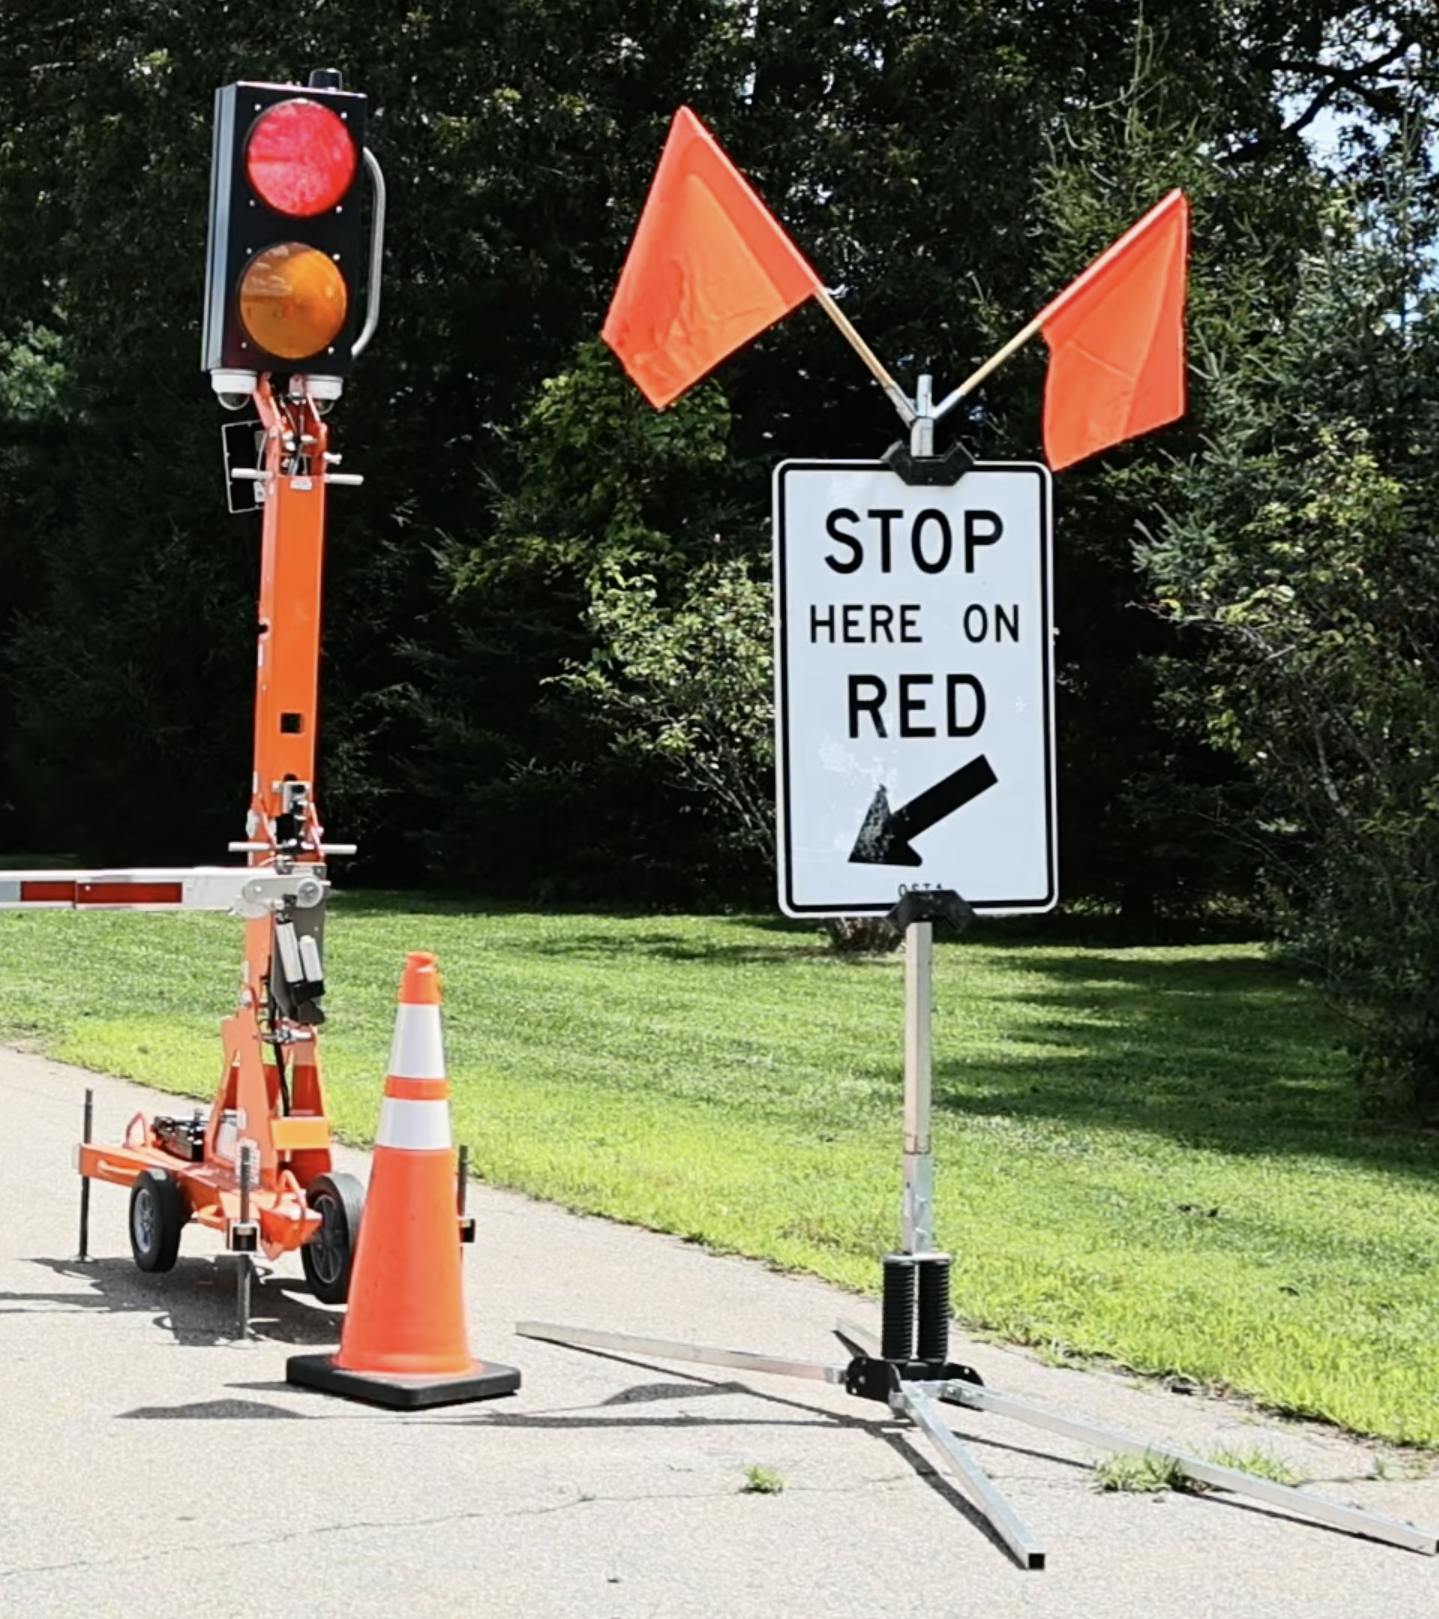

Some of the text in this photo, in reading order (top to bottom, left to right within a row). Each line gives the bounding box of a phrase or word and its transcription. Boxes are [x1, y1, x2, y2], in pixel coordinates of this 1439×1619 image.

[824, 507, 1004, 575] STOP
[810, 603, 1019, 644] HERE ON
[848, 674, 986, 739] RED
